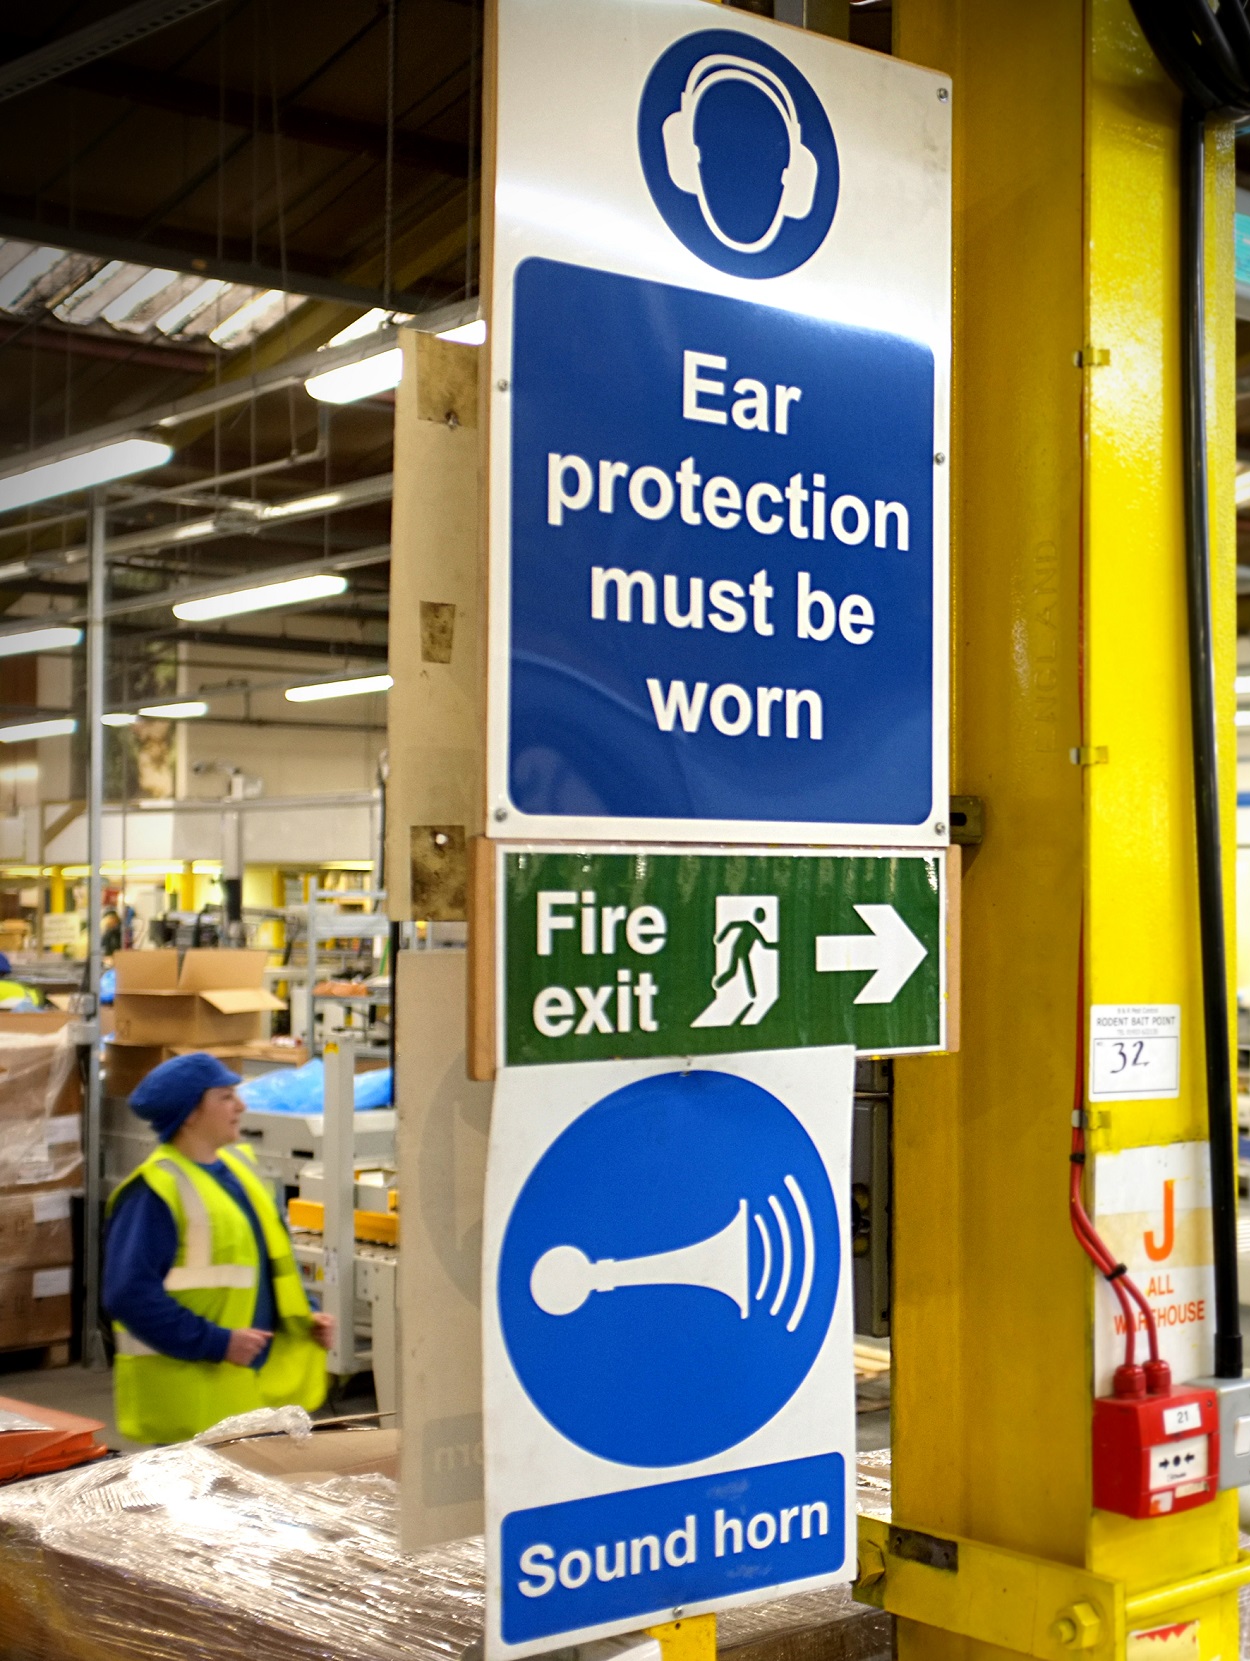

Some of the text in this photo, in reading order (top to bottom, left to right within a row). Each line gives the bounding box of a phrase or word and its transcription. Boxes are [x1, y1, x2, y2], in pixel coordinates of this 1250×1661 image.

[682, 349, 802, 435] Ear
[546, 451, 911, 552] protection
[590, 564, 876, 646] must be
[1034, 538, 1058, 754] ENGLAND
[645, 677, 824, 741] worn
[536, 890, 668, 956] Fire
[532, 968, 659, 1037] exit
[1096, 1016, 1176, 1027] RODENT BAIT POINT
[1110, 1040, 1150, 1073] 32
[1143, 1179, 1175, 1262] J
[1147, 1274, 1175, 1297] ALL
[1176, 1410, 1190, 1424] 21
[517, 1500, 829, 1599] Sound horn
